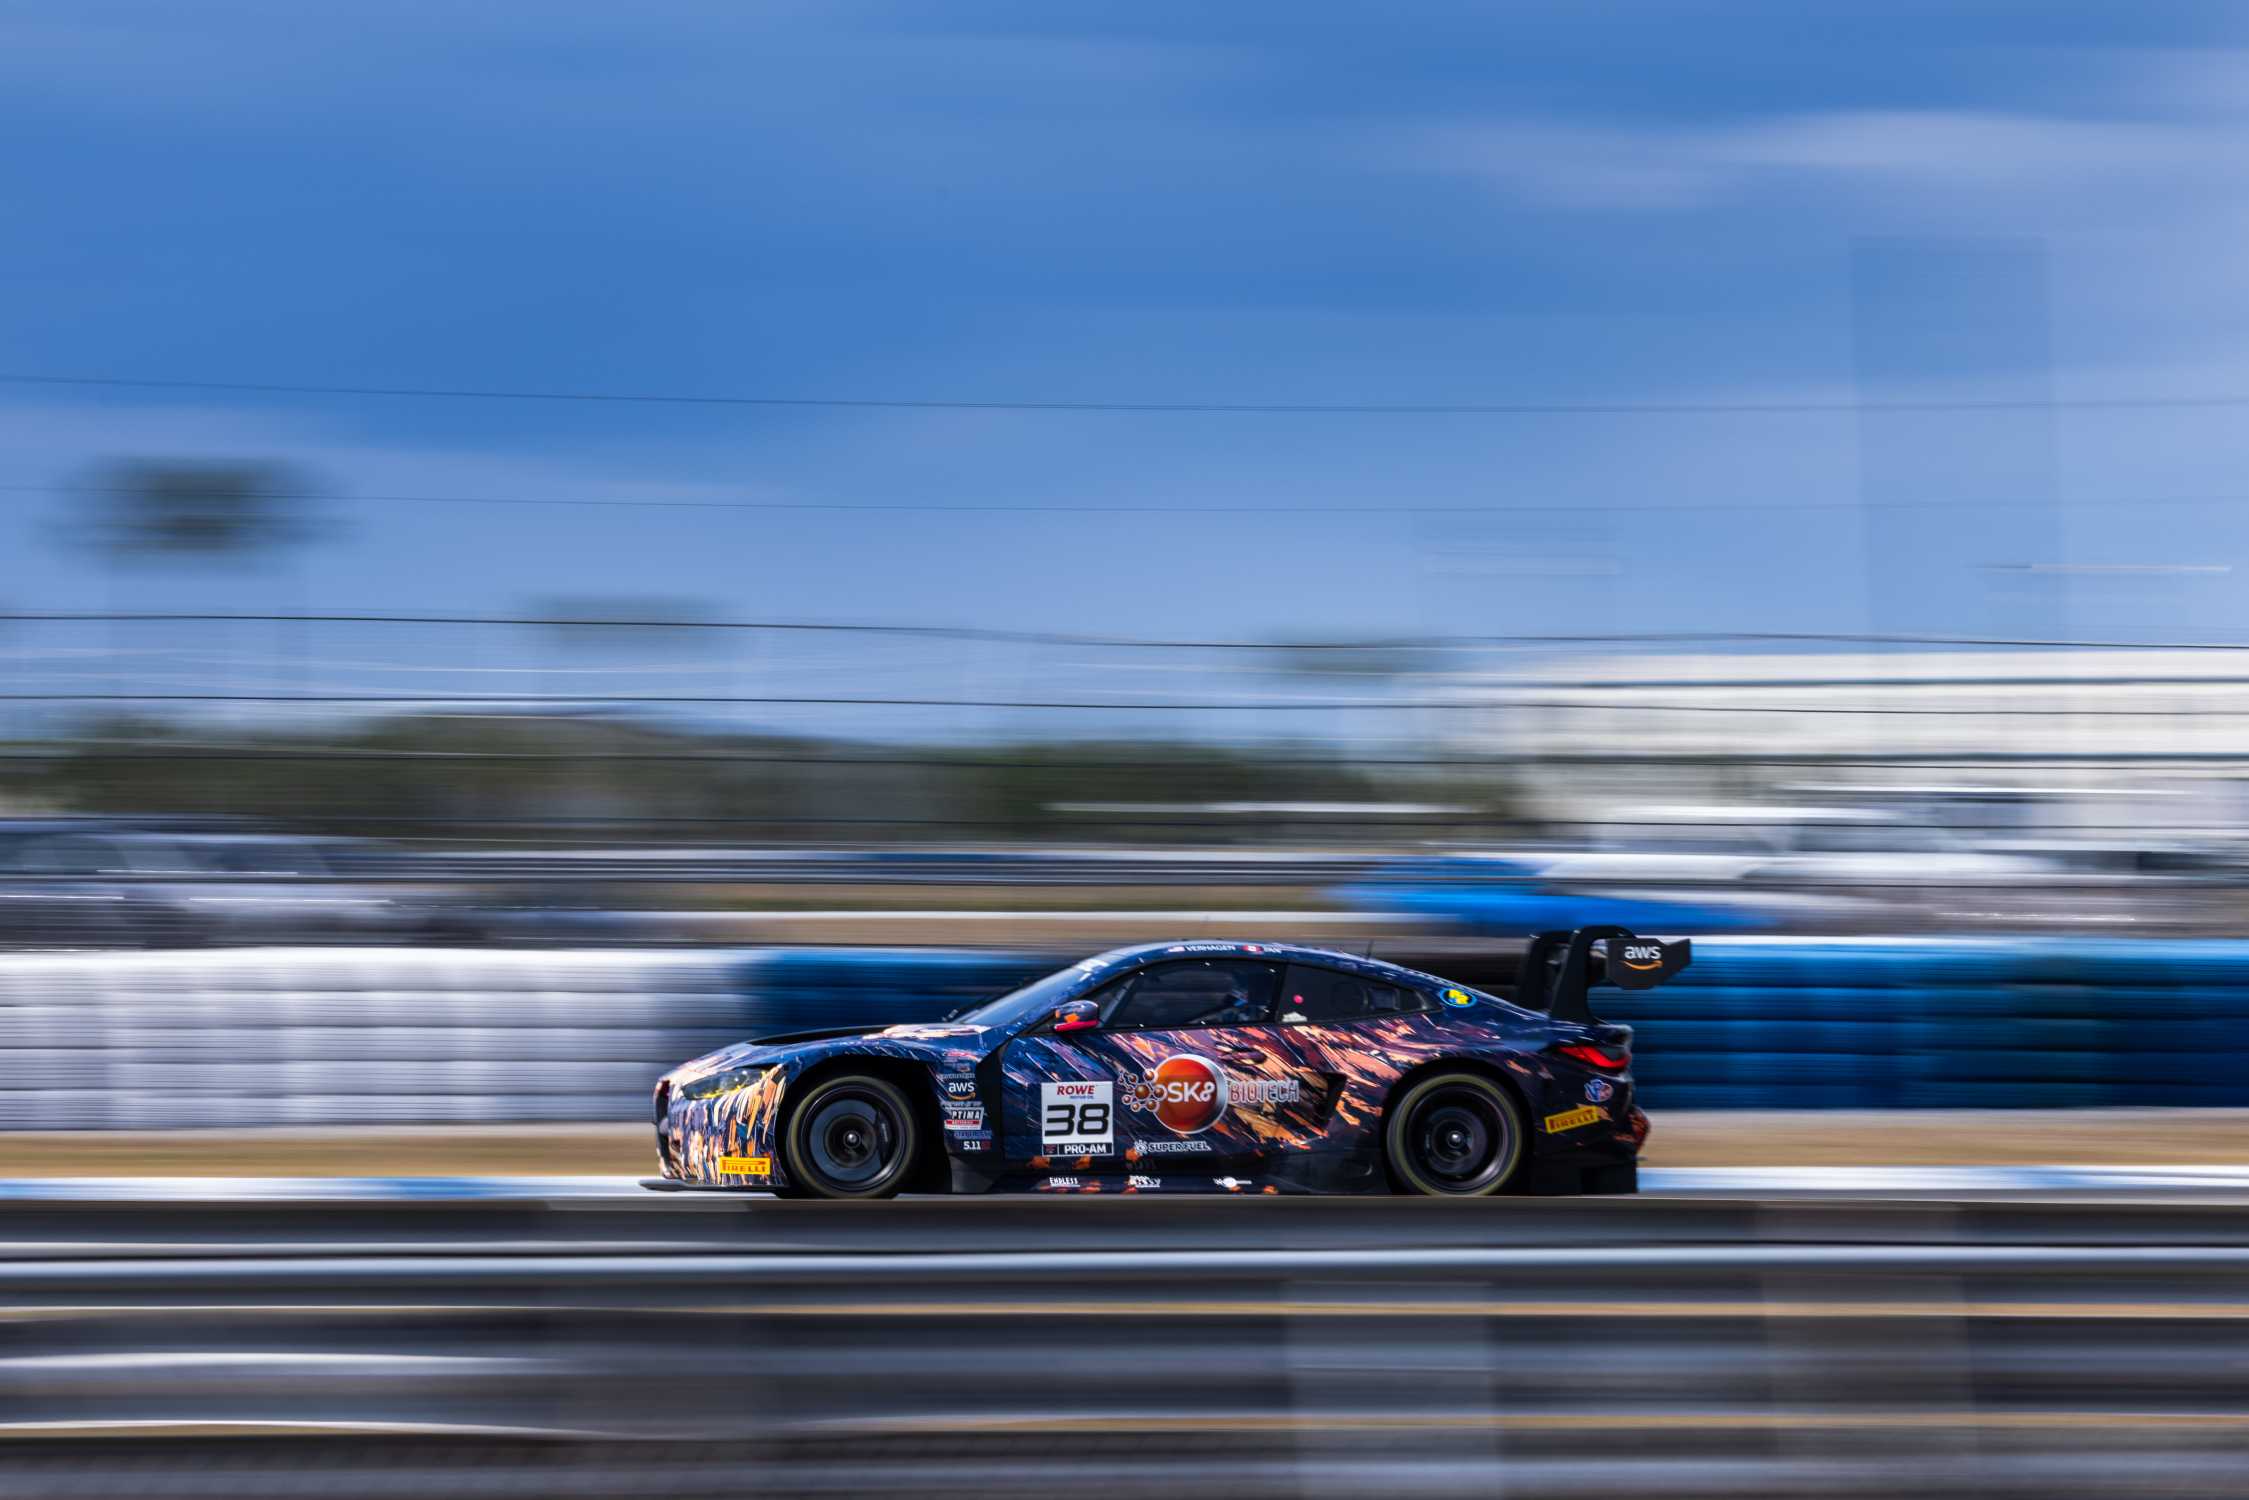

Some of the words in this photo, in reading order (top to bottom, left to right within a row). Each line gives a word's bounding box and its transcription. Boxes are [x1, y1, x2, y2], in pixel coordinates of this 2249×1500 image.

[1624, 945, 1662, 959] aws
[948, 1081, 975, 1093] aws
[1056, 1085, 1095, 1096] ROWE
[1167, 1081, 1215, 1103] SK8
[1228, 1080, 1299, 1104] BIOTECH
[1044, 1103, 1110, 1137] 38
[1548, 1109, 1596, 1130] PIRELLI
[963, 1140, 982, 1151] 5.11
[1064, 1143, 1107, 1155] PRO-AM
[722, 1159, 767, 1172] PIRELLI
[1049, 1176, 1079, 1186] ENDLESS
